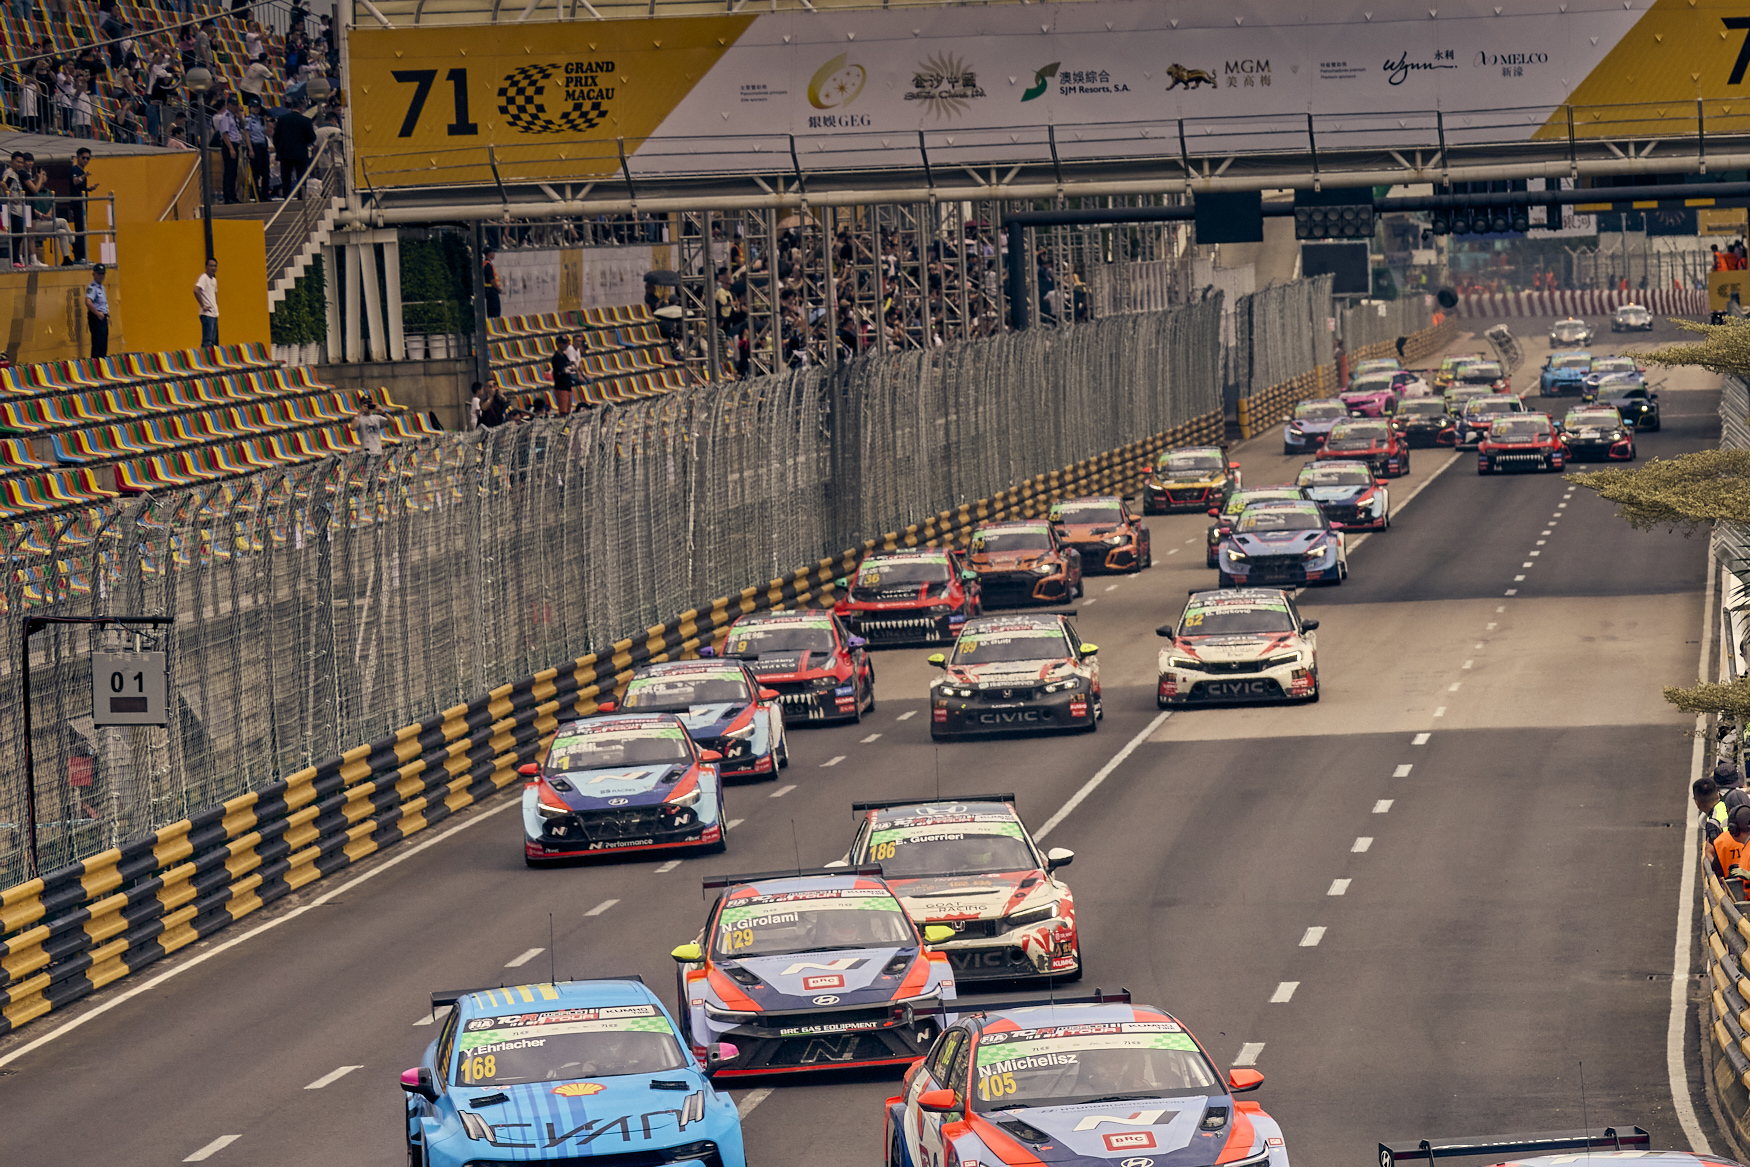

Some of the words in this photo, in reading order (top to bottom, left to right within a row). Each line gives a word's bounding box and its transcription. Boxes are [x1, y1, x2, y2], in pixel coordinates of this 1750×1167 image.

[1500, 53, 1548, 65] MELCO
[564, 60, 615, 75] GRAND
[1224, 59, 1272, 74] MGM
[1501, 66, 1524, 77] 新濠
[564, 75, 599, 88] PRIX
[912, 72, 976, 89] 金沙中國
[1059, 69, 1111, 85] 澳娛綜合
[1226, 75, 1272, 88] 美高梅
[564, 87, 615, 102] MACAU
[1060, 86, 1077, 96] SJM
[1078, 85, 1112, 94] Resorts,
[1114, 83, 1131, 92] S.A.
[390, 68, 478, 138] 71
[808, 115, 836, 128] 銀娛
[838, 114, 871, 127] GEG
[864, 573, 880, 587] 36
[1185, 614, 1204, 627] 62
[737, 640, 748, 652] 9
[959, 641, 978, 654] 199
[1207, 682, 1264, 695] CIVIC
[980, 711, 1038, 724] CIVIC
[557, 756, 570, 770] 1
[605, 838, 653, 849] Performance
[910, 833, 964, 844] Guerrieri
[869, 842, 896, 861] 186
[1730, 848, 1741, 859] 71
[938, 904, 988, 913] RACING
[721, 911, 799, 933] N.Girolami
[724, 929, 754, 950] 129
[950, 953, 1000, 969] VIC
[469, 1019, 494, 1030] FIA
[823, 1022, 878, 1031] EQUIPMENT
[980, 1033, 1007, 1044] FIA
[463, 1038, 546, 1057] Y.Ehrlacher
[461, 1055, 496, 1082] 168
[978, 1053, 1078, 1078] N.Michelisz
[978, 1072, 1017, 1100] 105
[1115, 1136, 1144, 1144] BRC
